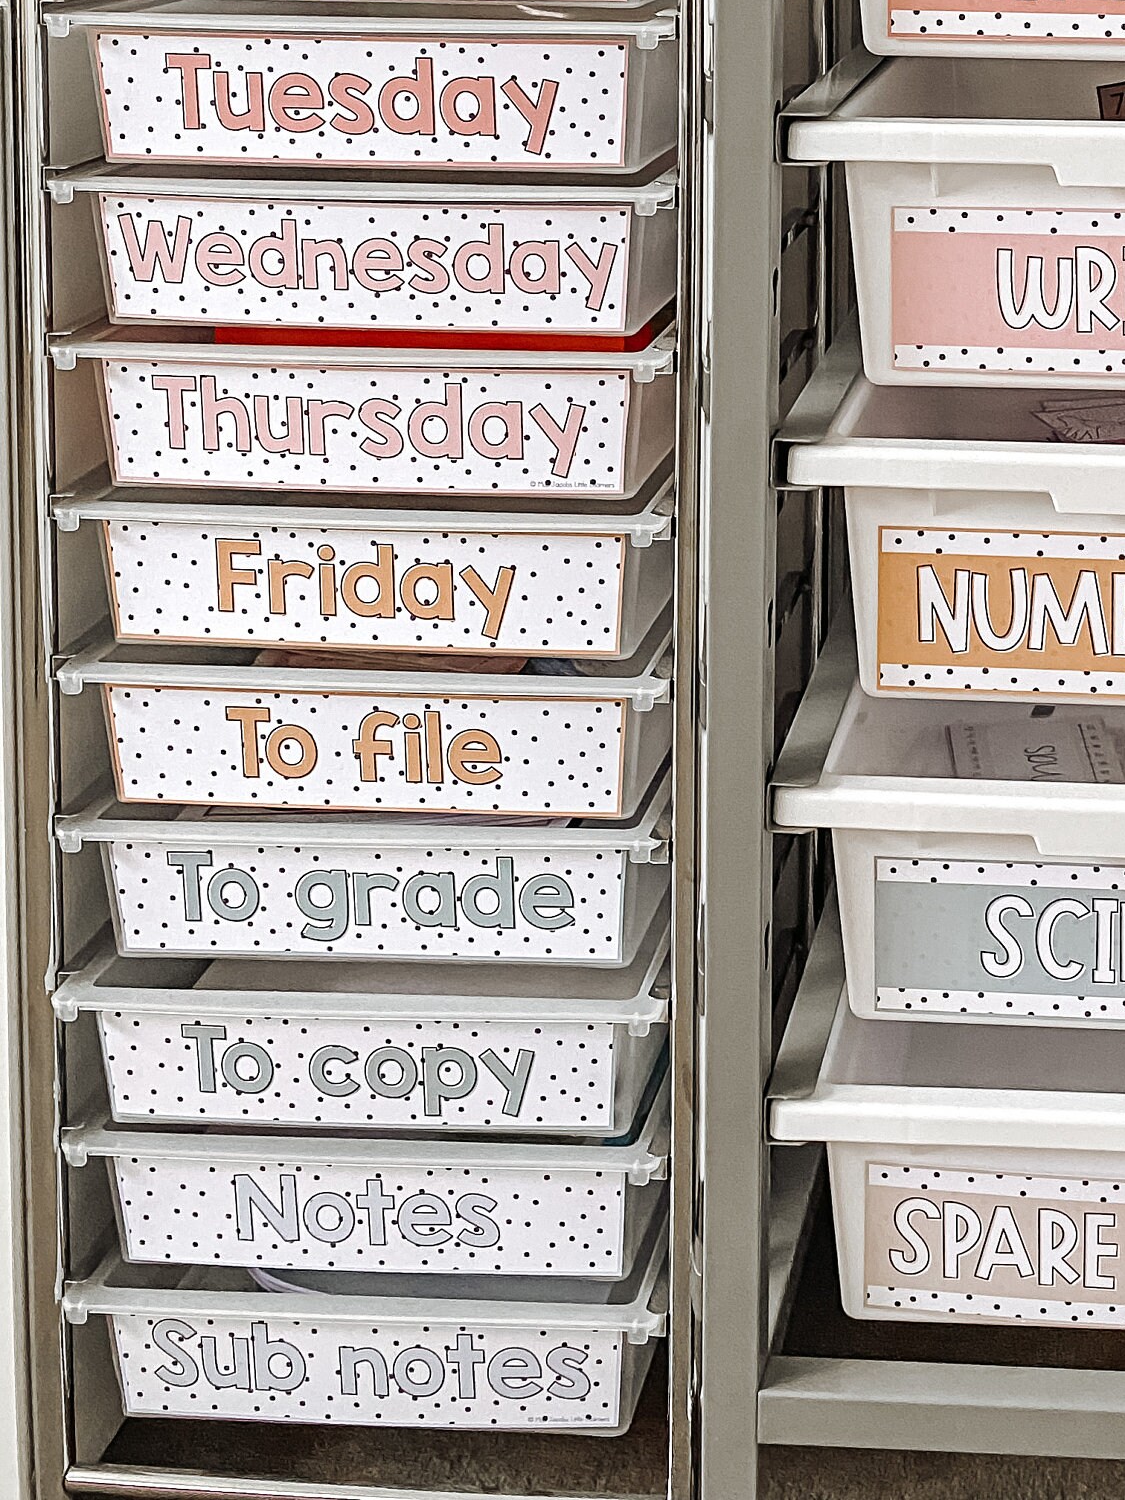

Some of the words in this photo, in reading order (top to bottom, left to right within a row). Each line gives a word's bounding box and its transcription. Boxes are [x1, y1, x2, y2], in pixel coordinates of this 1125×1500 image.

[165, 52, 560, 156] Tuesday
[118, 213, 619, 312] Wednesday
[152, 374, 587, 479] Thursday
[215, 537, 517, 640] Friday
[226, 706, 318, 779] To
[352, 710, 504, 786] file
[167, 851, 260, 922] To
[295, 856, 576, 941] grade
[181, 1023, 274, 1094] To
[308, 1044, 535, 1118] copy
[233, 1174, 501, 1248] Notes
[888, 1196, 1120, 1290] SPARE
[151, 1318, 307, 1391] Sub
[338, 1332, 593, 1400] notes
